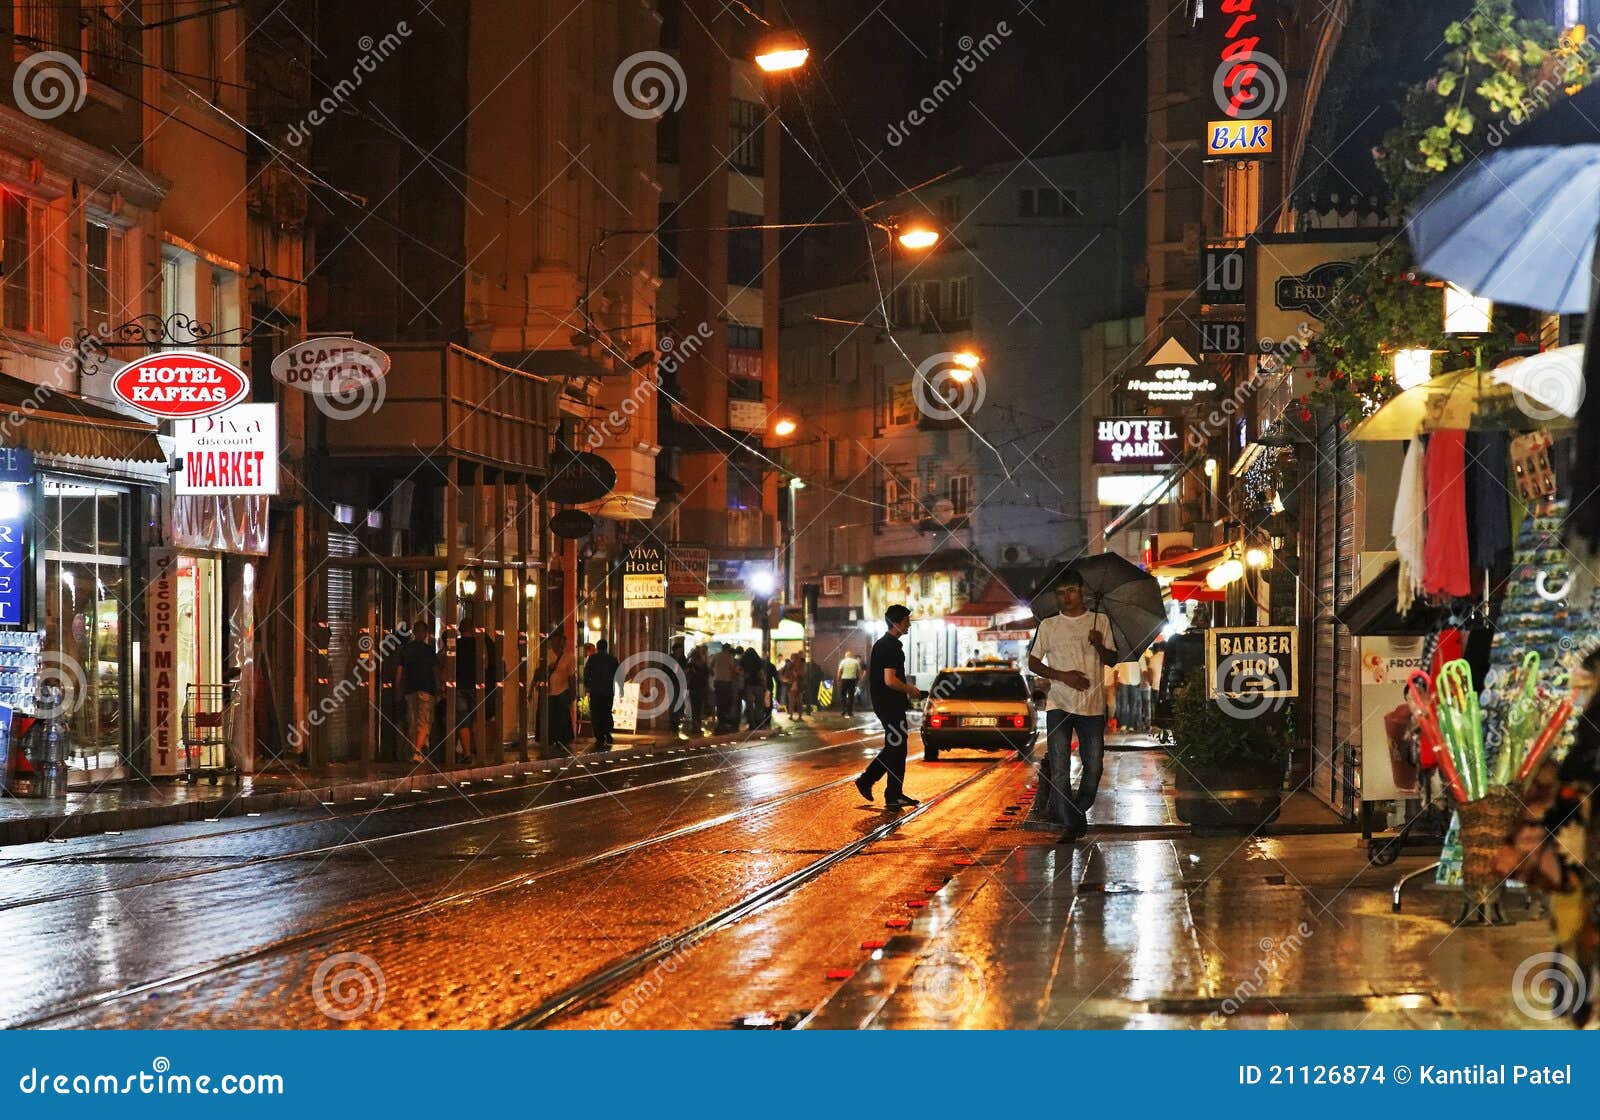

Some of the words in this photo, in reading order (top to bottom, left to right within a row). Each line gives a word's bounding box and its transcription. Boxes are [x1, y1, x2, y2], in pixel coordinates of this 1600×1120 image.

[1211, 125, 1269, 150] BAR
[1206, 253, 1244, 291] LO
[1294, 284, 1327, 299] RED
[301, 348, 354, 364] CAFE
[138, 367, 222, 383] HOTEL
[132, 387, 227, 402] KAFKAS
[191, 416, 262, 433] Diva
[1098, 421, 1178, 441] HOTEL
[197, 437, 253, 445] discount
[187, 451, 264, 488] MARKET
[626, 560, 663, 572] Hotel
[156, 557, 170, 644] discount
[1220, 636, 1290, 655] BARBER
[1231, 657, 1280, 676] SHOP
[155, 651, 171, 767] MARKET
